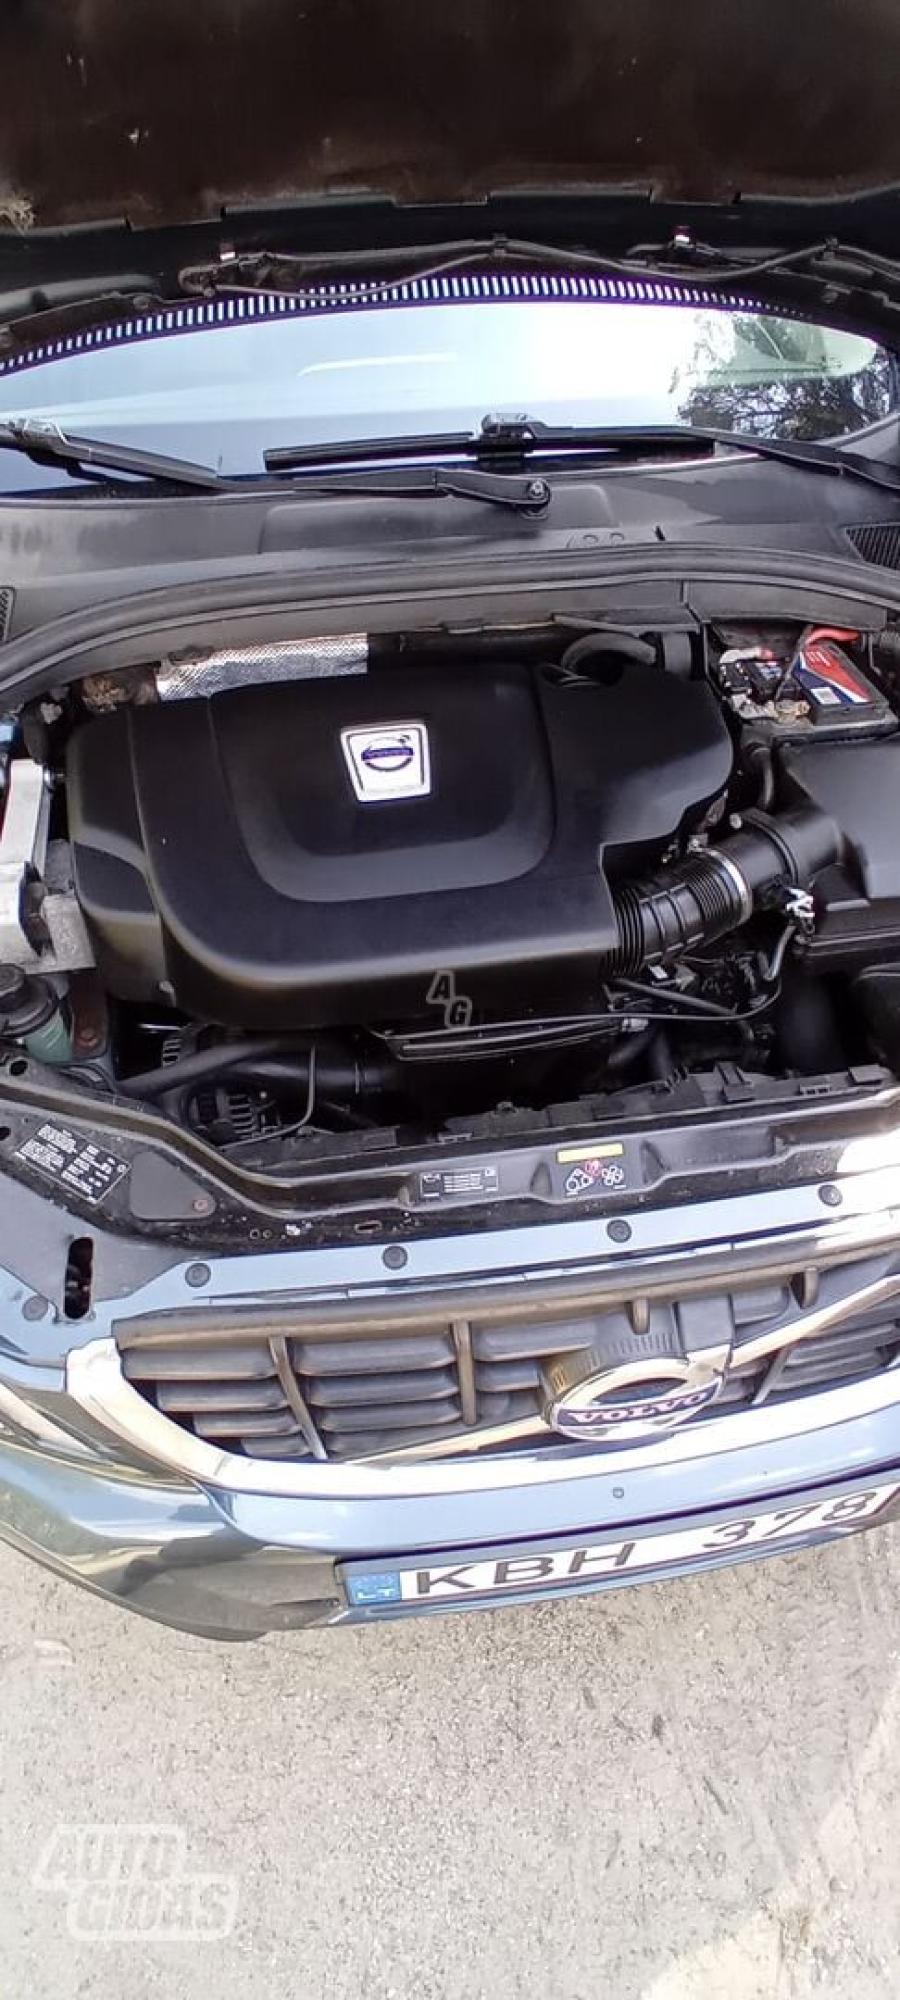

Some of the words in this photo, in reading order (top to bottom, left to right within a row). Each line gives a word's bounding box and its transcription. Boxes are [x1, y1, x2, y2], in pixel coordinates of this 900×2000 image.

[566, 1391, 709, 1423] VOLVO
[416, 1541, 636, 1595] KBH
[702, 1492, 877, 1549] 378
[356, 1587, 395, 1599] LT
